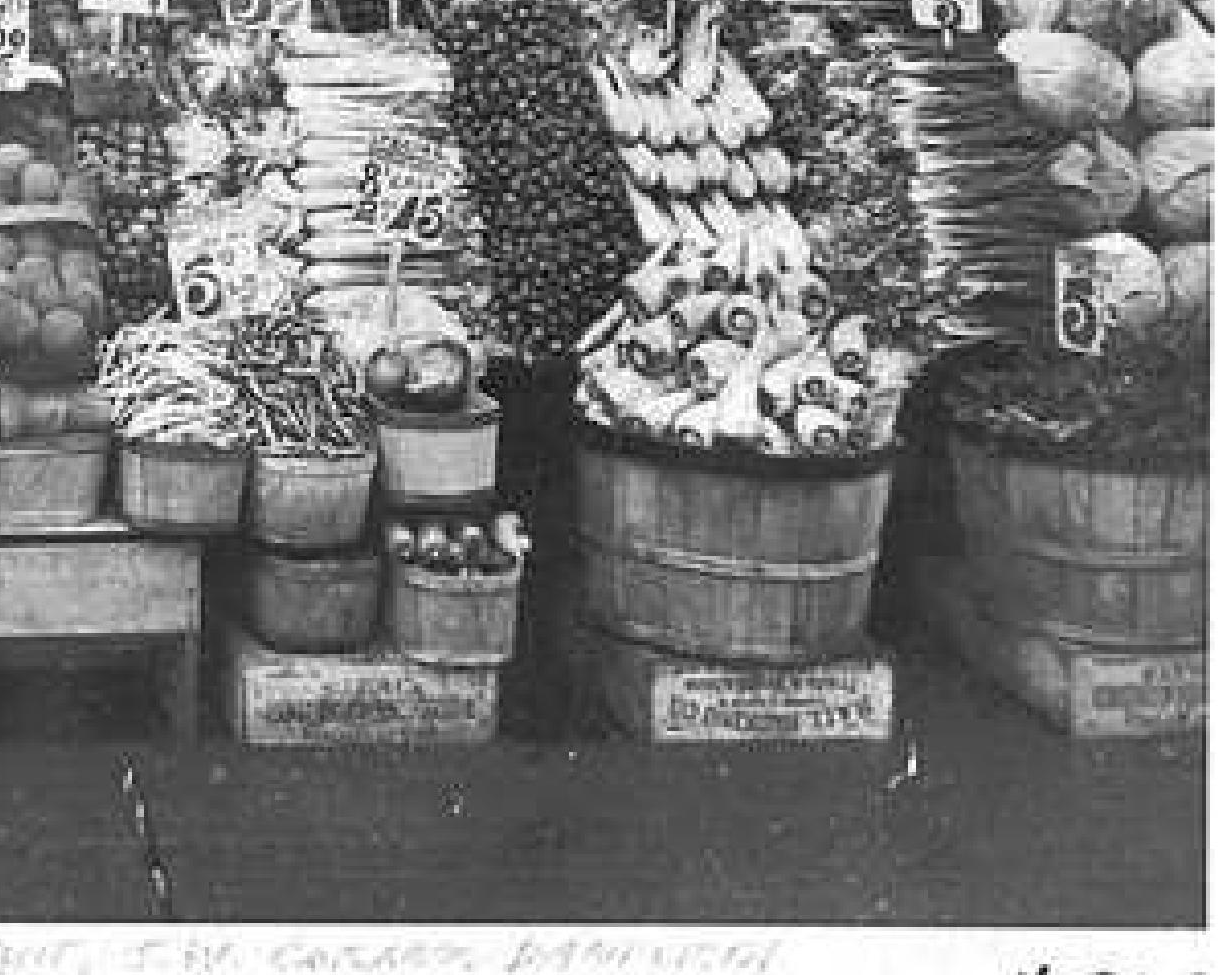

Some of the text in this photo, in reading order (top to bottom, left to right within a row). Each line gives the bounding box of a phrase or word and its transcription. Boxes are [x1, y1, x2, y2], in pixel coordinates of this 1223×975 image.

[384, 193, 445, 242] 15
[181, 253, 224, 319] 5
[1063, 276, 1099, 349] 5
